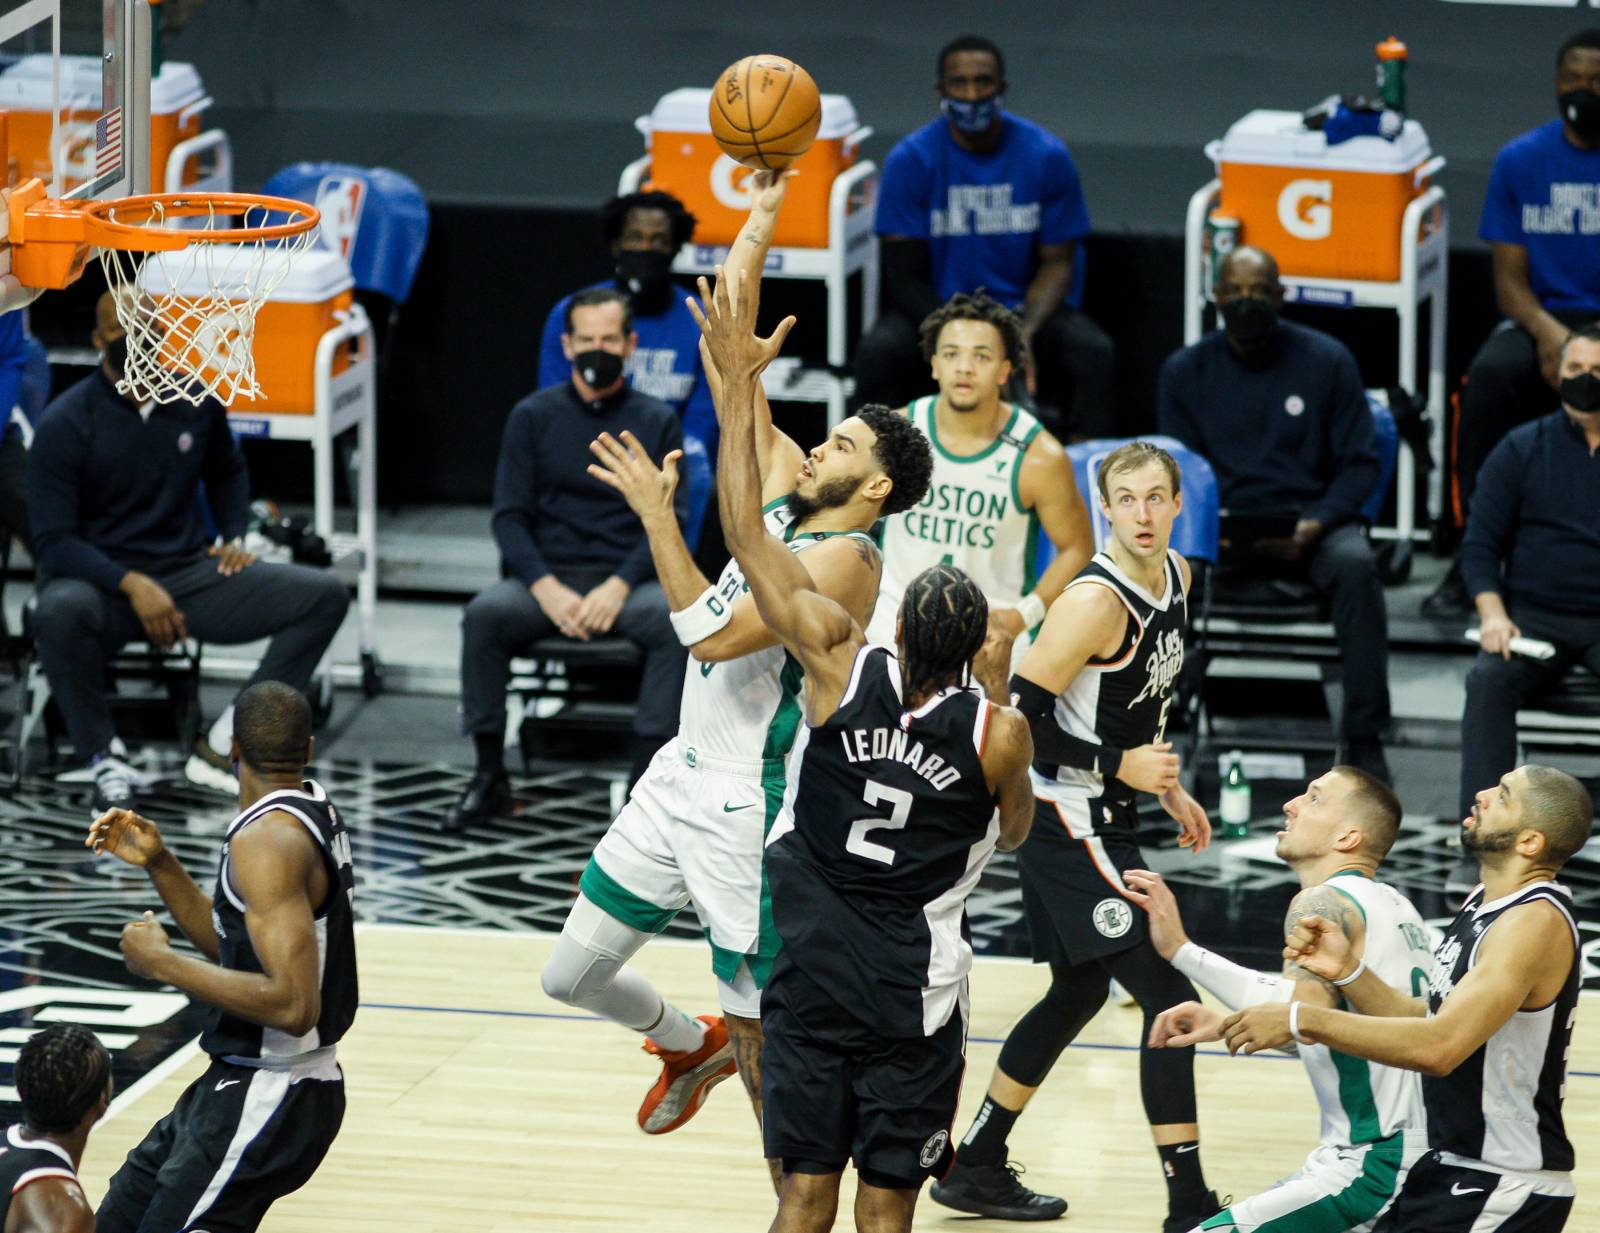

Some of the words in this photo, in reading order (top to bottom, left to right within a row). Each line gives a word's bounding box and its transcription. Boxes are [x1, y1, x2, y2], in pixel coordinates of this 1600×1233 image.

[1277, 179, 1332, 240] G
[904, 511, 996, 549] CELTICS
[919, 484, 1007, 520] OSTON
[840, 728, 962, 792] LEONARD
[846, 778, 914, 866] 2
